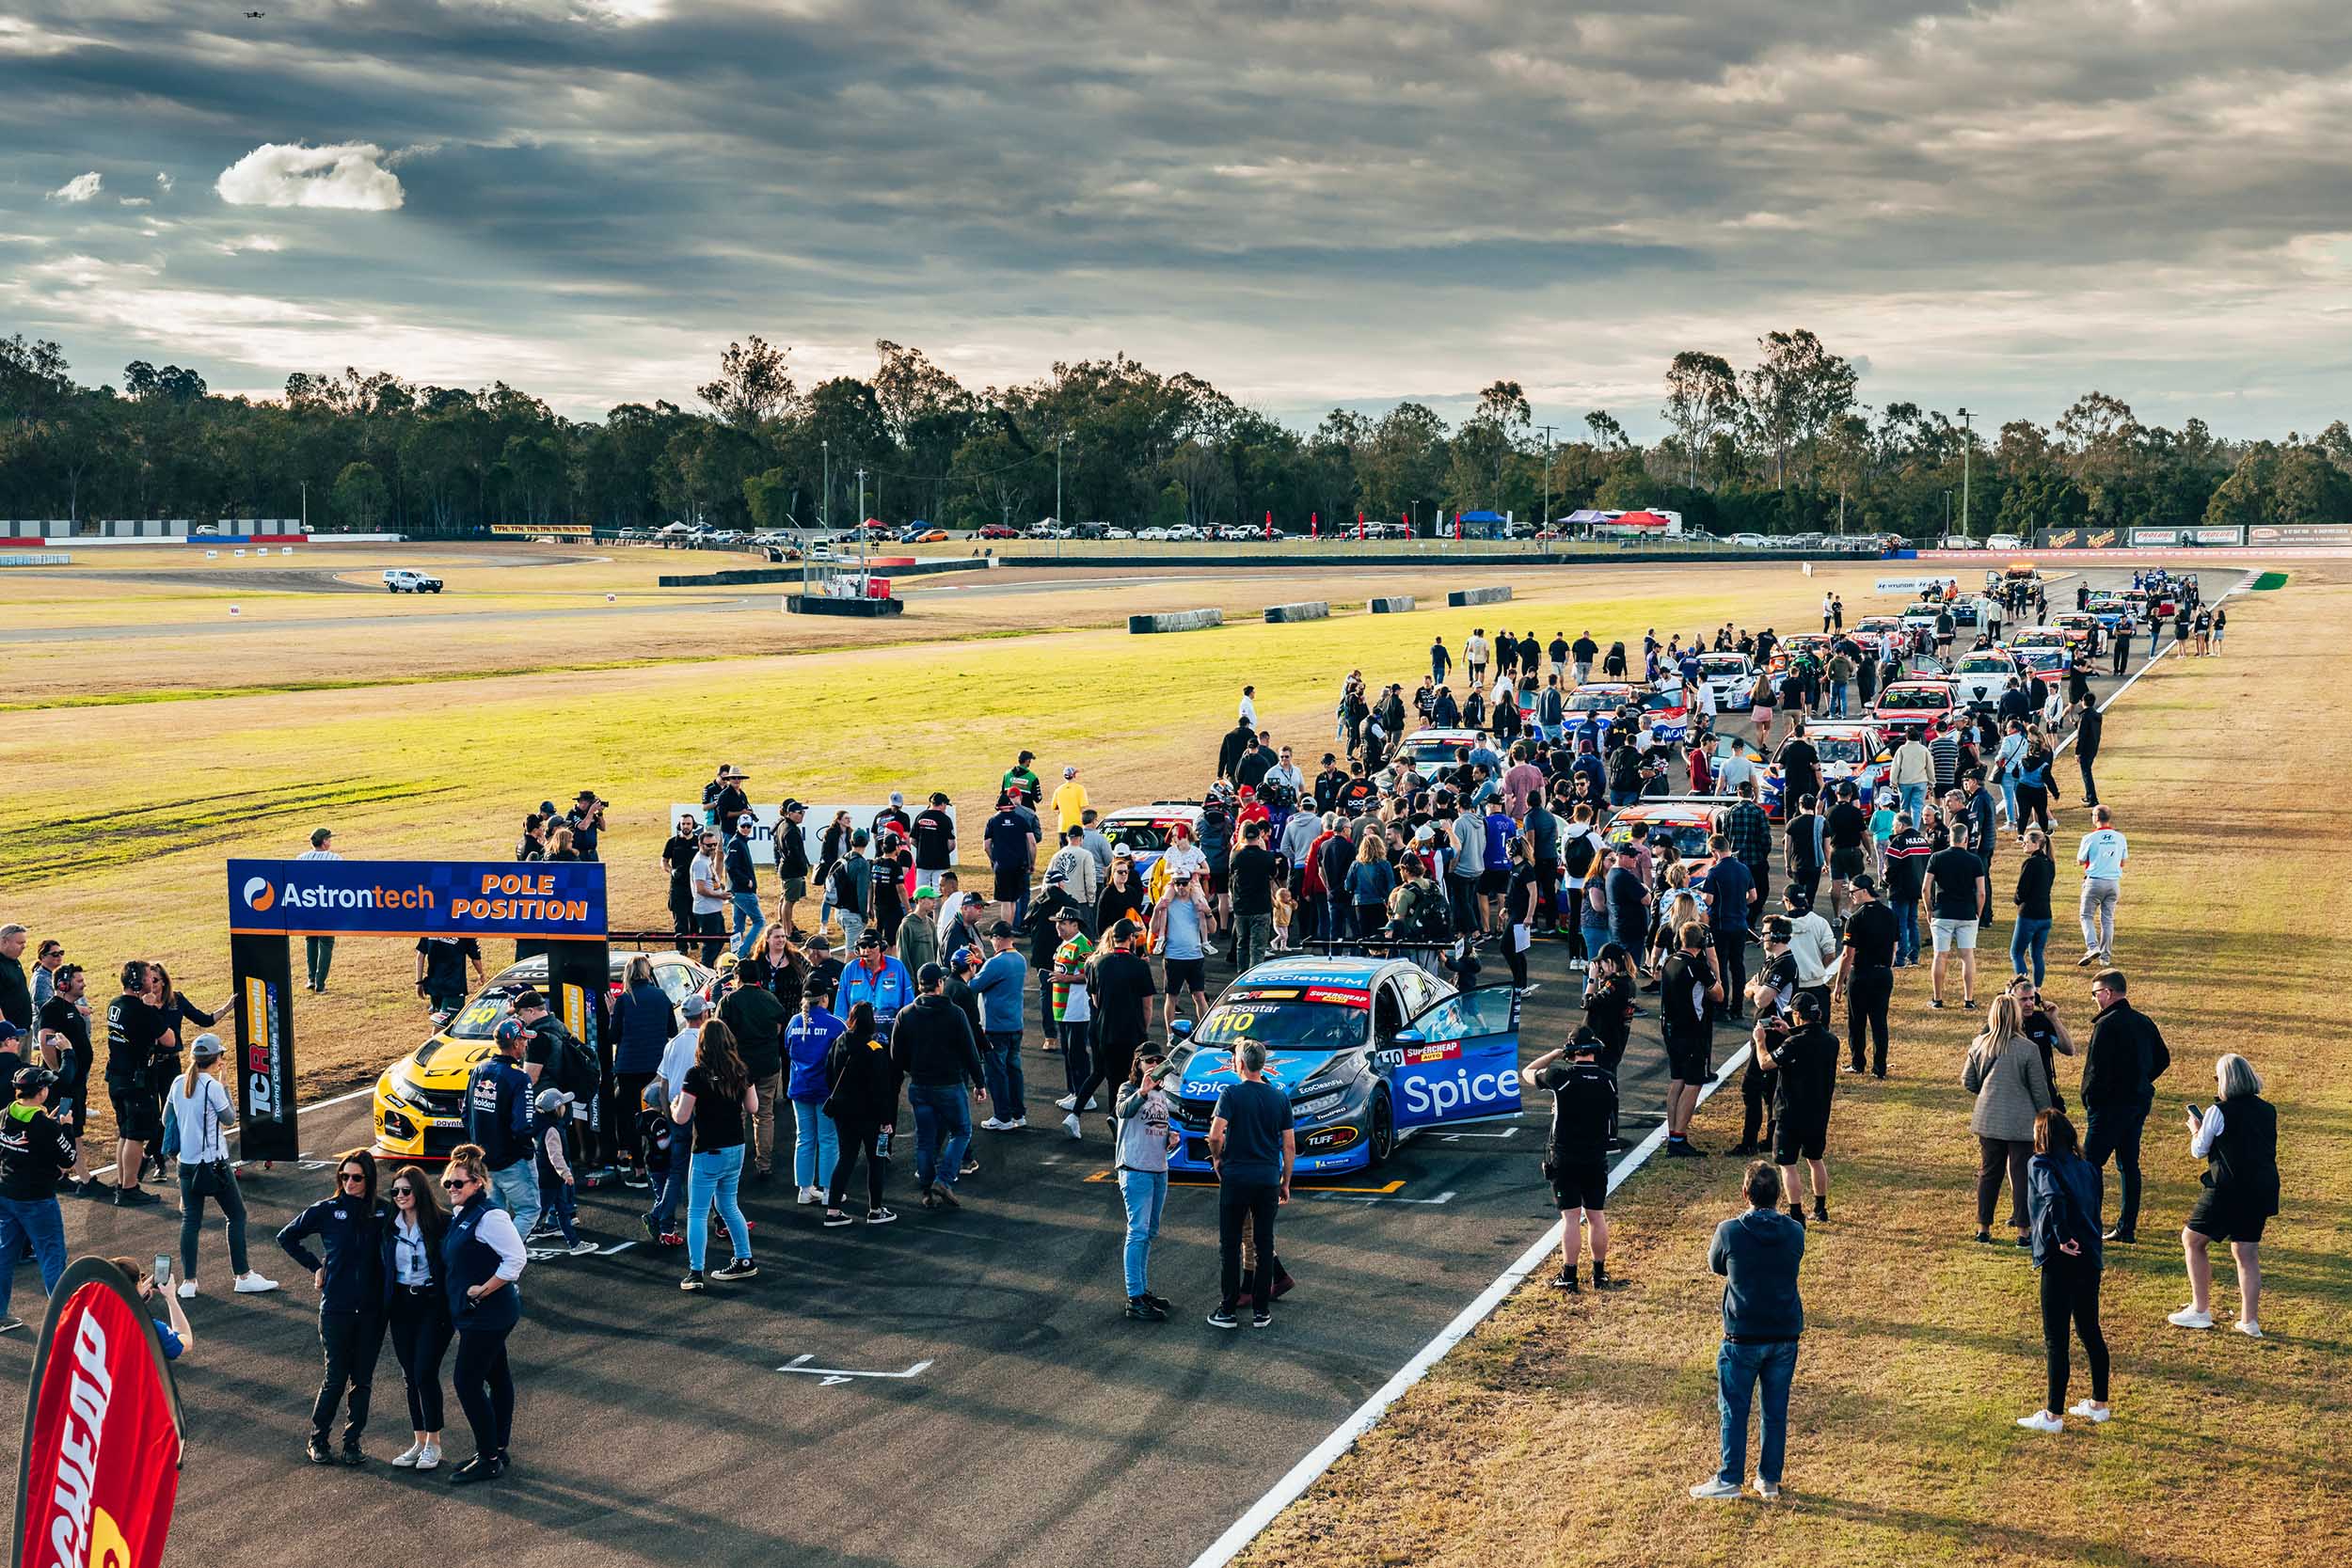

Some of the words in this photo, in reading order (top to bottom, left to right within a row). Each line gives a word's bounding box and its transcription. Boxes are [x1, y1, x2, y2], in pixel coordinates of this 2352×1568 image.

[481, 874, 555, 895] POLE
[283, 882, 435, 910] Astrontech
[451, 898, 588, 922] POSITION
[1245, 974, 1363, 986] EcoCleanFM
[1227, 990, 1263, 1002] TCR
[1309, 990, 1368, 1003] SUPERCHEAP
[252, 980, 263, 1043] Australia
[461, 1008, 498, 1024] 50
[1231, 1006, 1280, 1014] Soutar
[1210, 1013, 1255, 1034] 110
[814, 1027, 828, 1036] CITY
[1407, 1042, 1457, 1057] SUPERCHEAP
[1378, 1051, 1403, 1066] 110
[249, 1044, 271, 1117] TCR
[1299, 1079, 1344, 1094] EcoCleanFM
[1185, 1081, 1230, 1096] Spic
[1404, 1069, 1519, 1117] Spice
[273, 1085, 282, 1118] Touring
[473, 1099, 496, 1109] Holden
